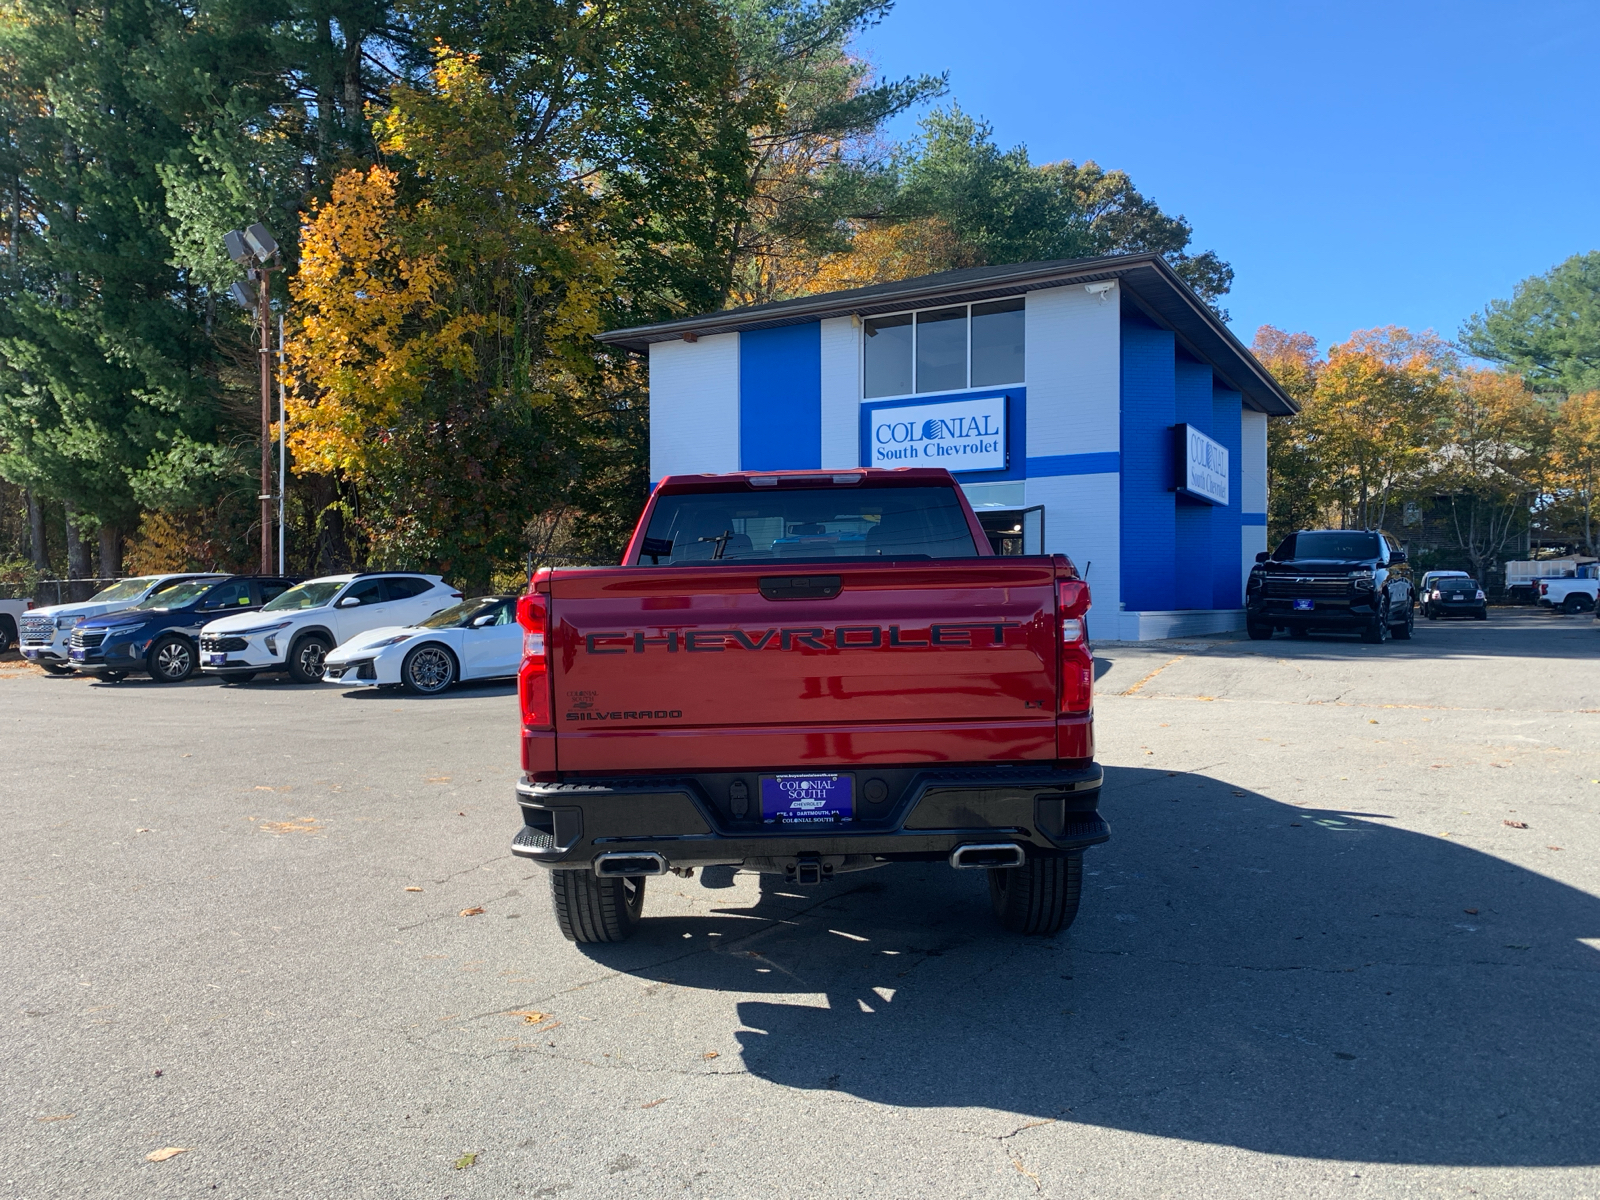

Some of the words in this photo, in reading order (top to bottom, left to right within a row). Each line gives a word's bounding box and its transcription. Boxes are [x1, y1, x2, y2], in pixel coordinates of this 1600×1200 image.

[876, 415, 999, 444] COLONIAL
[877, 444, 918, 461] South
[924, 439, 999, 458] Chevrolet
[1190, 433, 1226, 478] COLONIAL
[1191, 466, 1206, 490] South
[1206, 473, 1227, 499] Chevrolet
[585, 621, 1021, 655] CHEVROLET
[1025, 699, 1045, 709] LT
[566, 710, 682, 721] SILVERADO
[779, 780, 834, 790] COLONIAL
[788, 790, 826, 799] SOUTH
